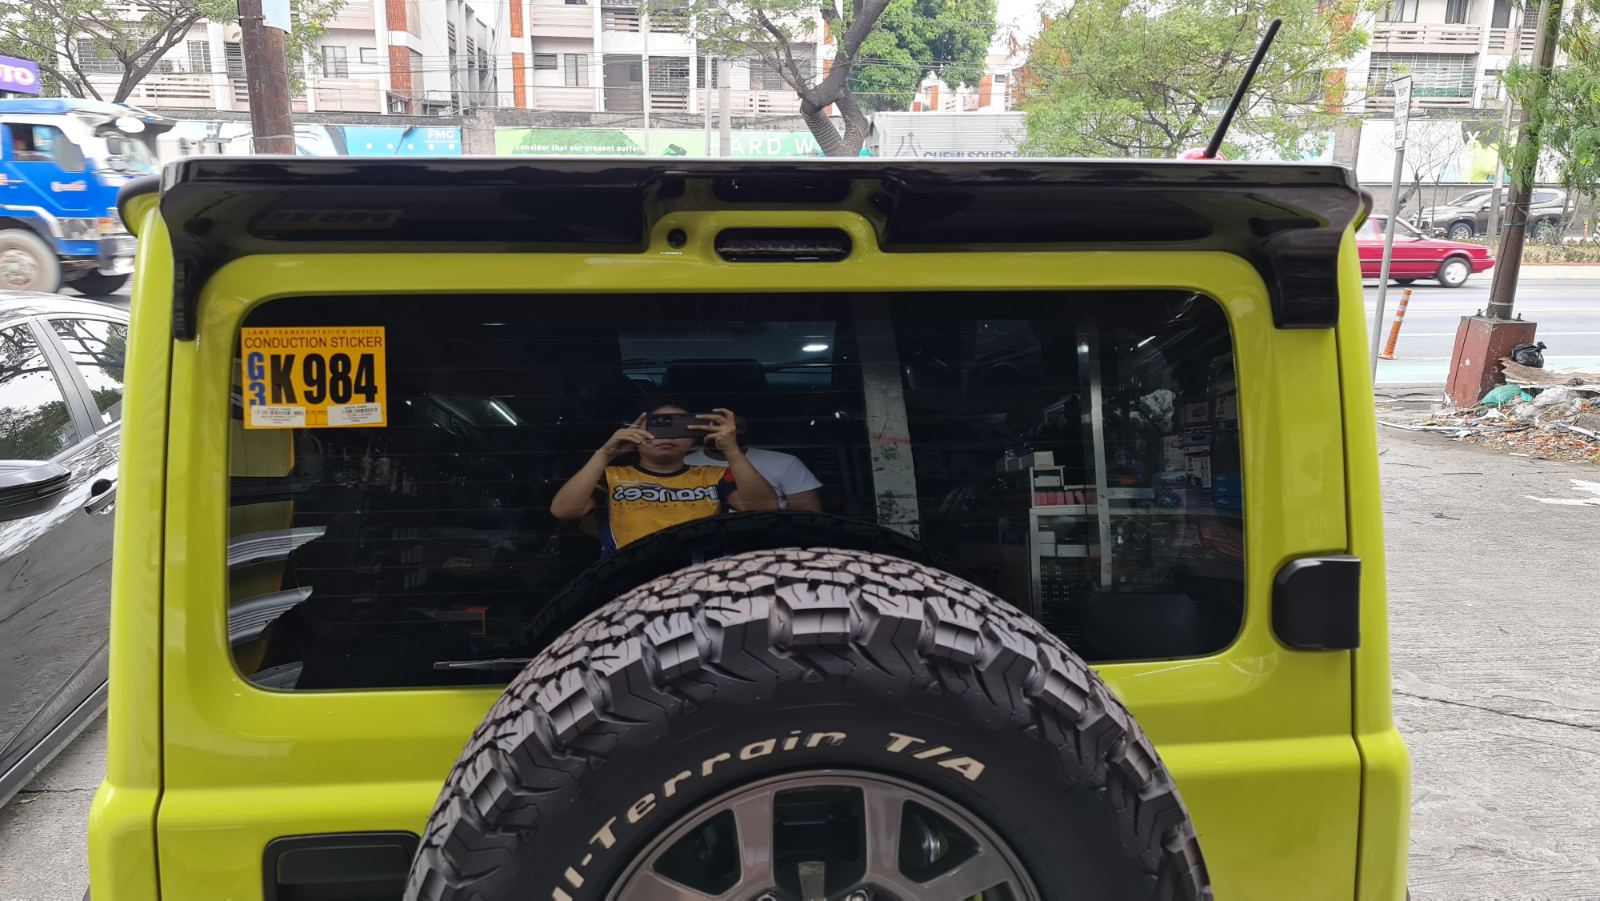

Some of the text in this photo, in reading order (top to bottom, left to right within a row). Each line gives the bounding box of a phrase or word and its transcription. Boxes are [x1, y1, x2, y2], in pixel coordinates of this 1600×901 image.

[244, 336, 382, 348] CONDUCTION STICKER
[886, 732, 985, 781] T/A
